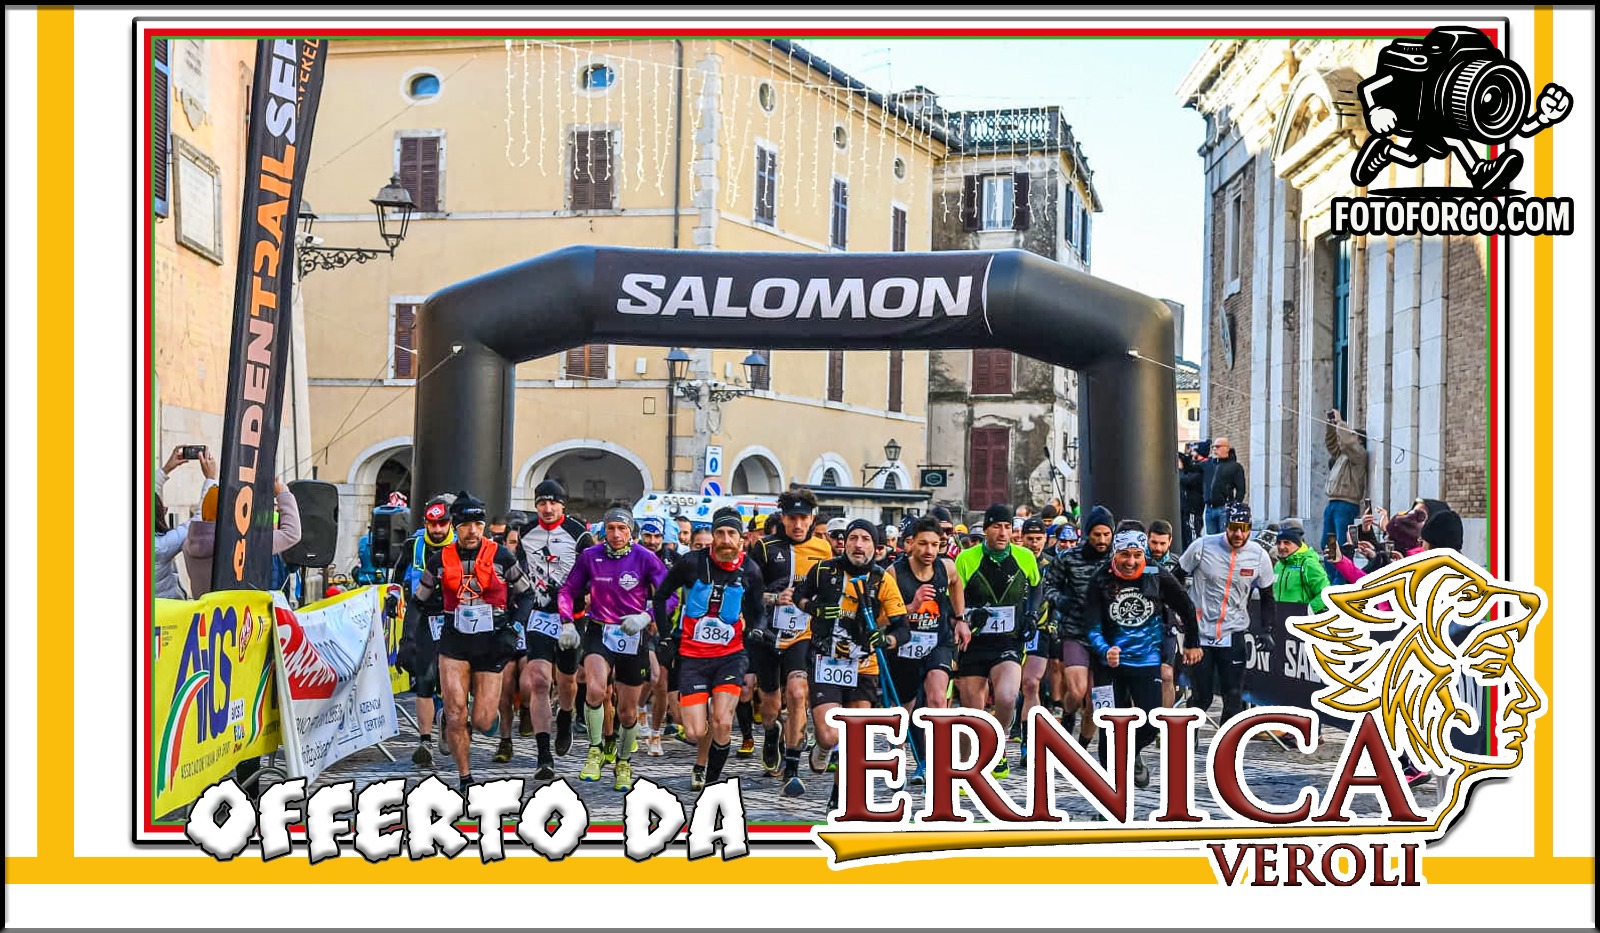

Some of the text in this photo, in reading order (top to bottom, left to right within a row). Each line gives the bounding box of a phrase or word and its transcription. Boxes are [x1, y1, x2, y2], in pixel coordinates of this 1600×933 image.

[615, 272, 973, 319] SALOMON
[470, 618, 478, 632] 7
[533, 618, 559, 636] 273
[788, 616, 797, 630] 5
[990, 619, 1007, 632] 41
[701, 626, 731, 643] 384
[617, 638, 627, 652] 9
[823, 667, 853, 685] 306
